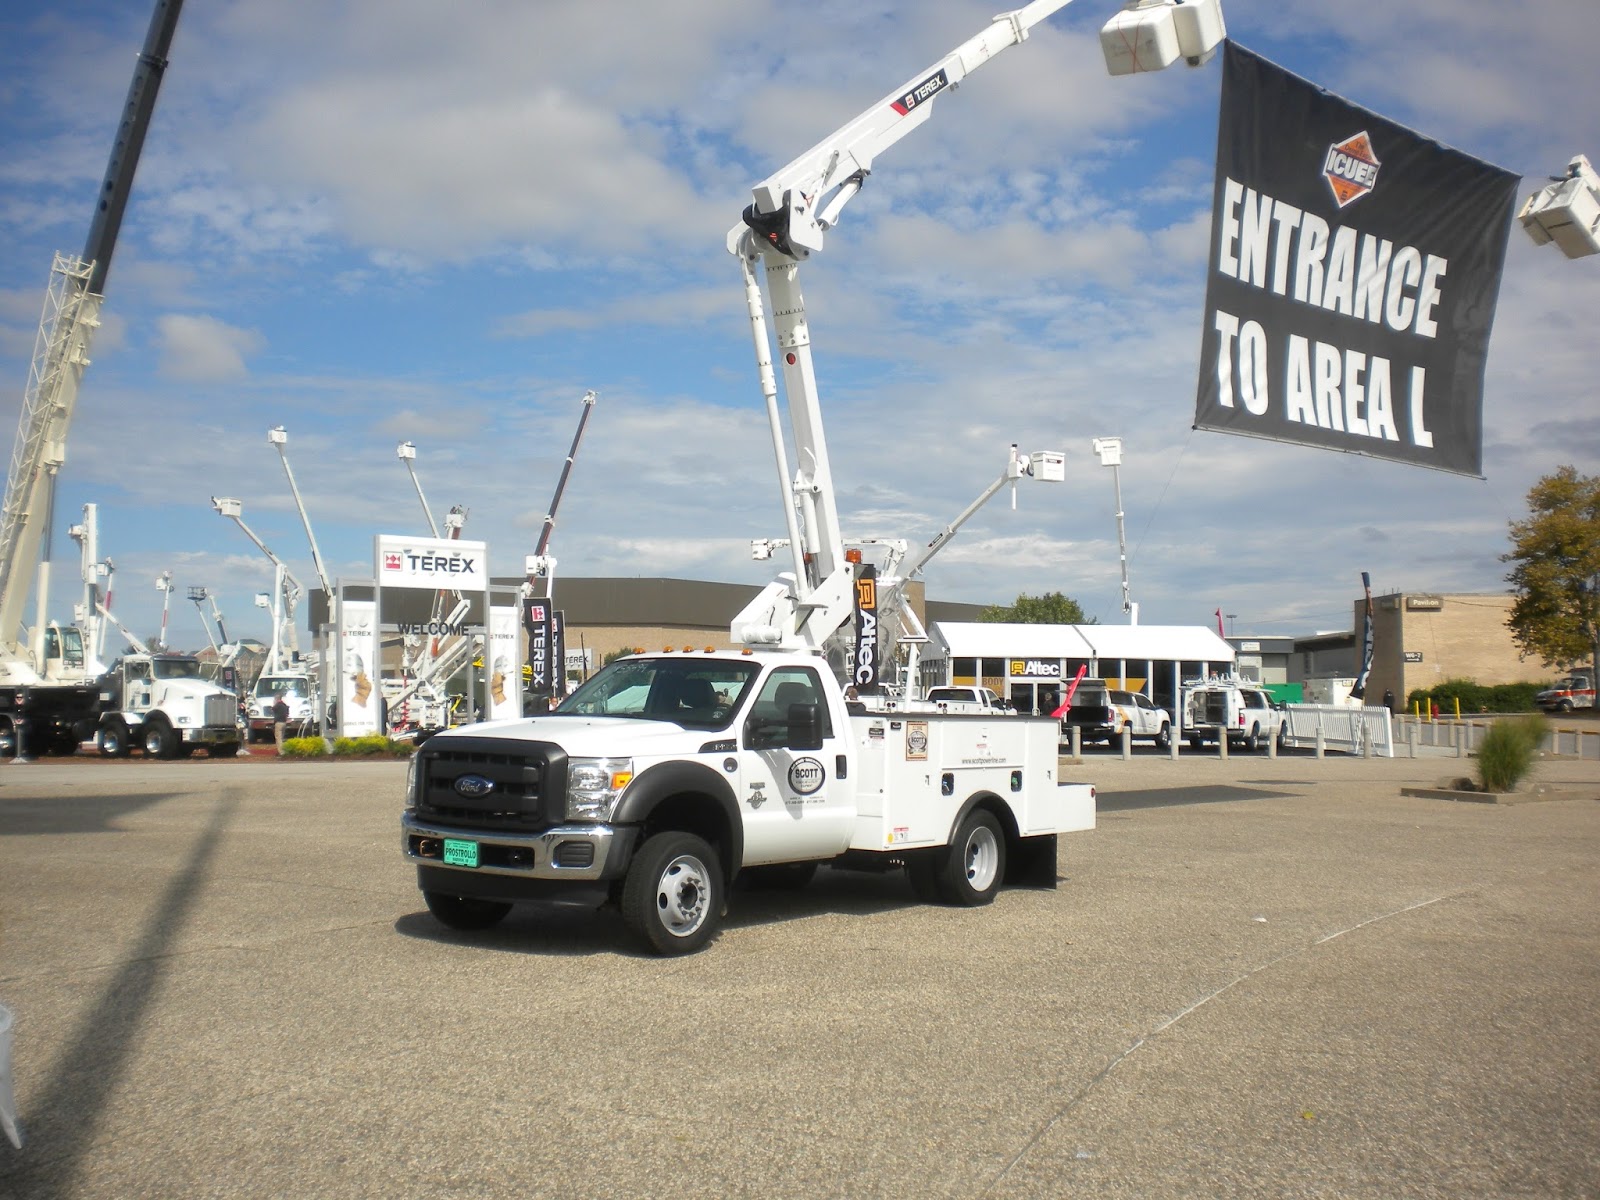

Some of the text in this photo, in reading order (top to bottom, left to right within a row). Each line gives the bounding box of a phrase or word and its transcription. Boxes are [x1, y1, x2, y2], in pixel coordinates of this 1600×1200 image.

[914, 75, 941, 101] TEREX
[1327, 150, 1377, 187] ICUEE
[1219, 177, 1447, 338] ENTRANCE
[1216, 310, 1434, 448] TO AREA L
[407, 555, 475, 574] TEREX
[398, 622, 469, 636] WELCOME
[533, 625, 546, 686] TEREX
[856, 608, 876, 685] Altec
[1024, 661, 1060, 676] Altec
[982, 677, 1004, 686] BODY
[795, 769, 818, 778] SCOTT
[460, 779, 480, 792] Ford
[445, 848, 476, 859] PROSTROLLO
